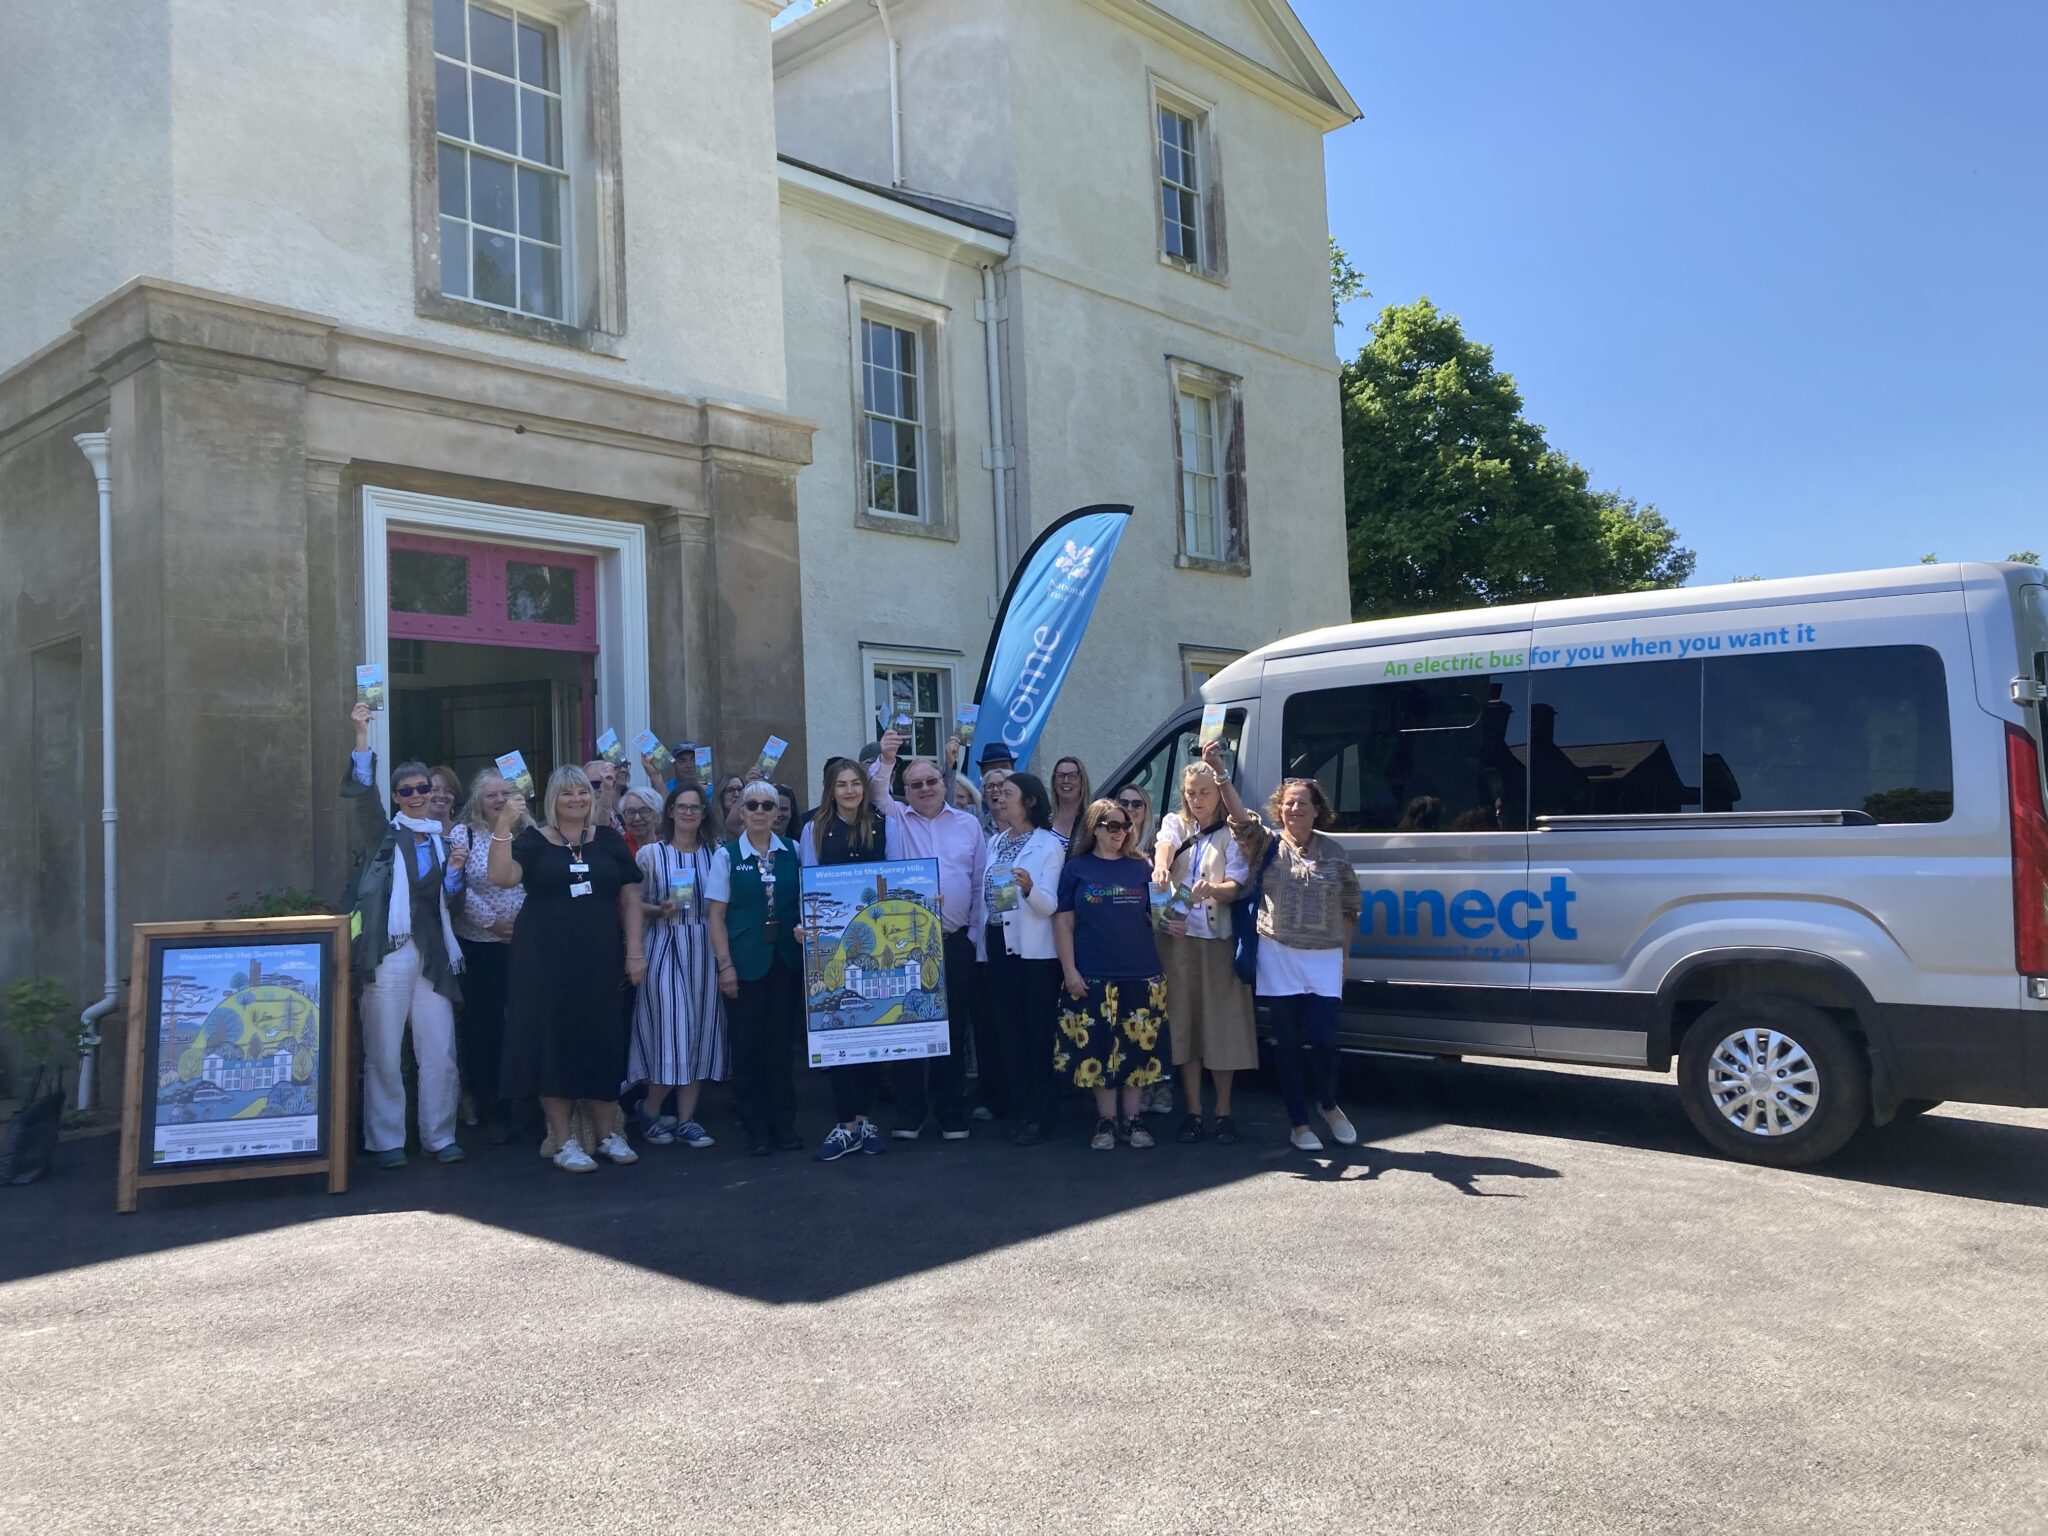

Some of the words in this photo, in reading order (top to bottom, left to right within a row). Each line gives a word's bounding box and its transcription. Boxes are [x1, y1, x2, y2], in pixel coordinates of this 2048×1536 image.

[1382, 660, 1408, 677] An
[1413, 652, 1484, 674] electric
[1489, 650, 1524, 668] bus
[1531, 646, 1560, 664] for
[1566, 645, 1604, 666] you
[1611, 637, 1672, 658] when
[1678, 635, 1721, 658] you
[1728, 627, 1789, 649] want
[1797, 623, 1815, 643] it
[1001, 625, 1060, 759] come
[815, 868, 854, 878] Welcome
[854, 868, 863, 876] to
[864, 867, 878, 876] the
[879, 866, 906, 874] Surrey
[907, 864, 925, 872] Hills
[1359, 876, 1578, 941] nnect
